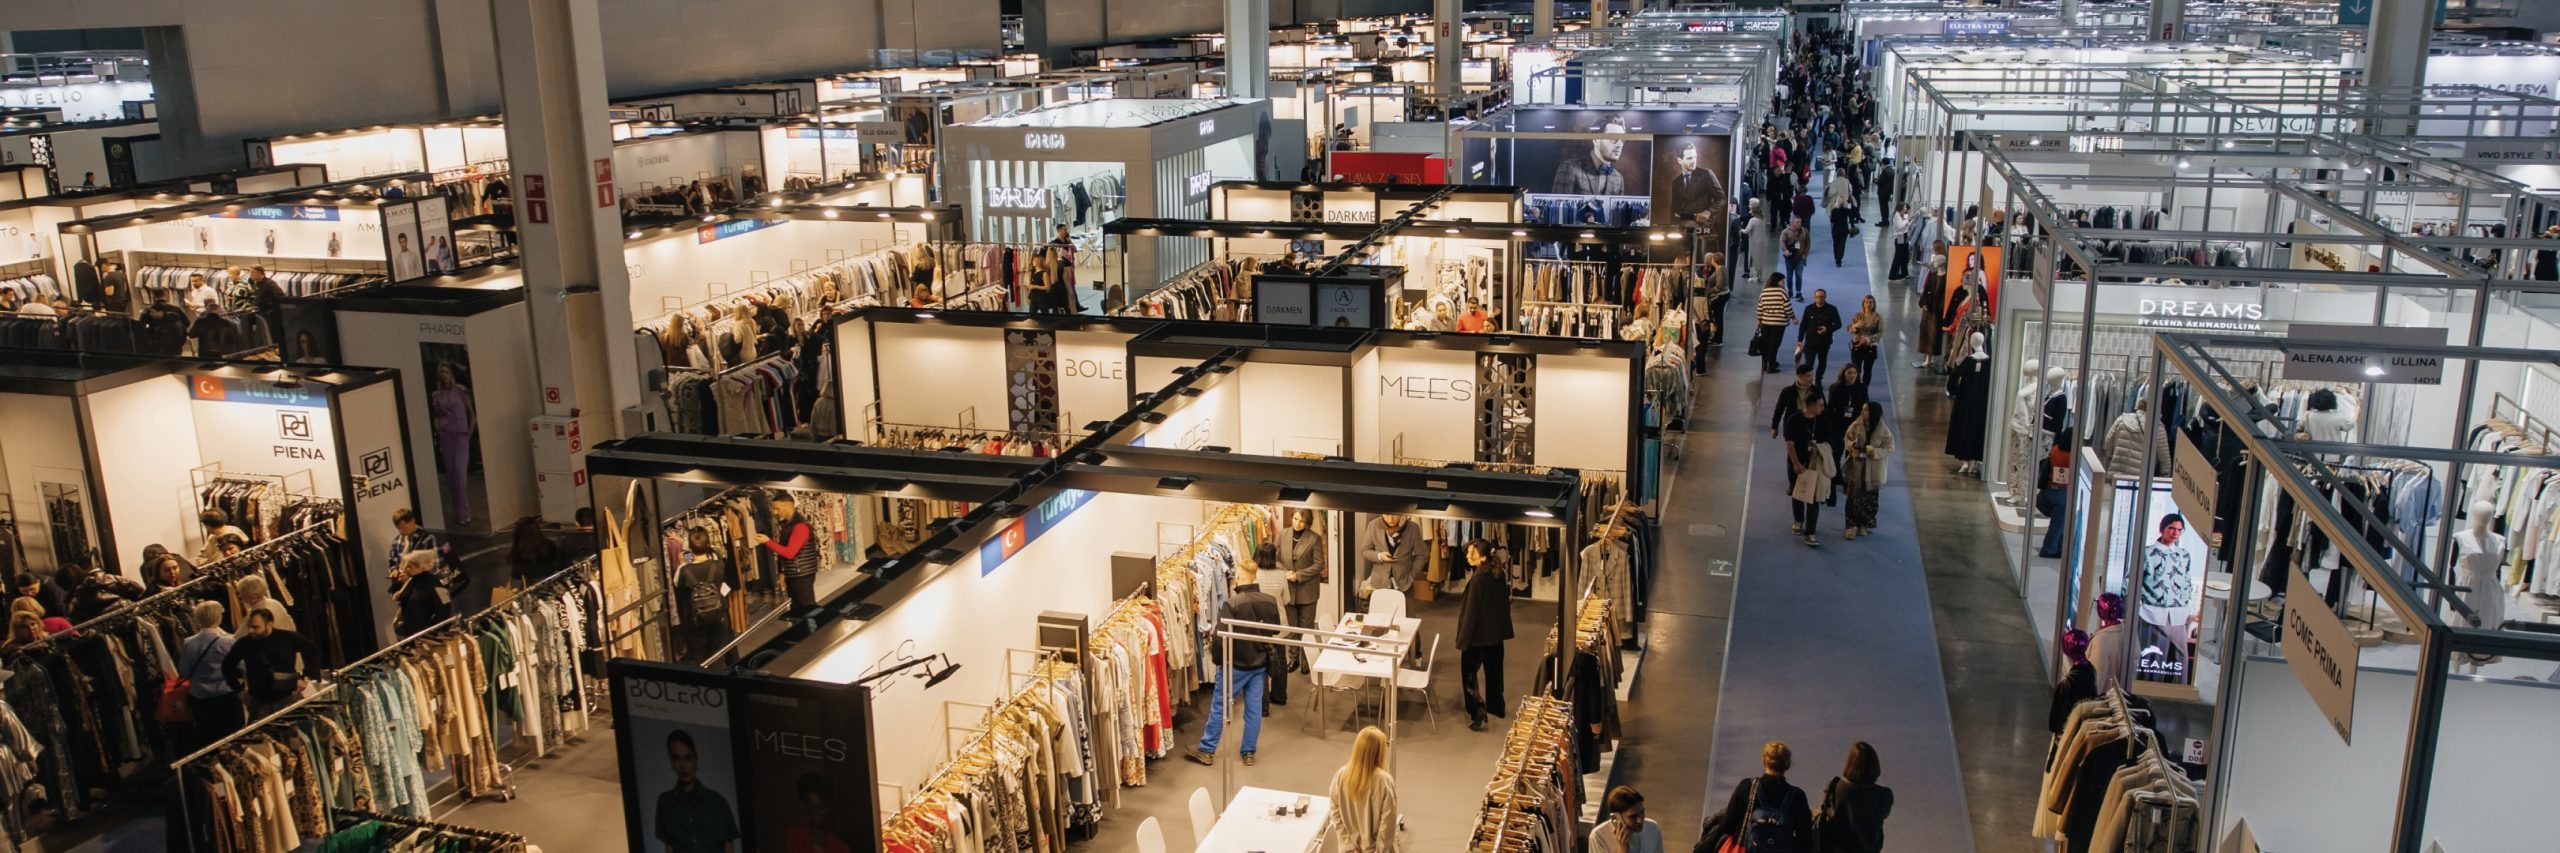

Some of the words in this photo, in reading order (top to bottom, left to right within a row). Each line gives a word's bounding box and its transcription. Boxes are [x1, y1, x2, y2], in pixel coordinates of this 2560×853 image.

[20, 91, 82, 105] VELLO
[2478, 151, 2501, 159] VIVO
[2503, 152, 2535, 160] STYLE
[1267, 306, 1303, 314] DARKMEN
[2140, 299, 2263, 320] DREAMS
[2152, 319, 2183, 328] ALENA
[2292, 354, 2333, 364] ALENA
[1381, 375, 1473, 402] MEES
[273, 446, 326, 461] PIENA
[356, 477, 403, 503] PIENA
[2291, 608, 2315, 653] COME
[2314, 640, 2343, 690] PRIMA
[630, 679, 724, 708] BOLERO
[755, 729, 847, 762] MEES
